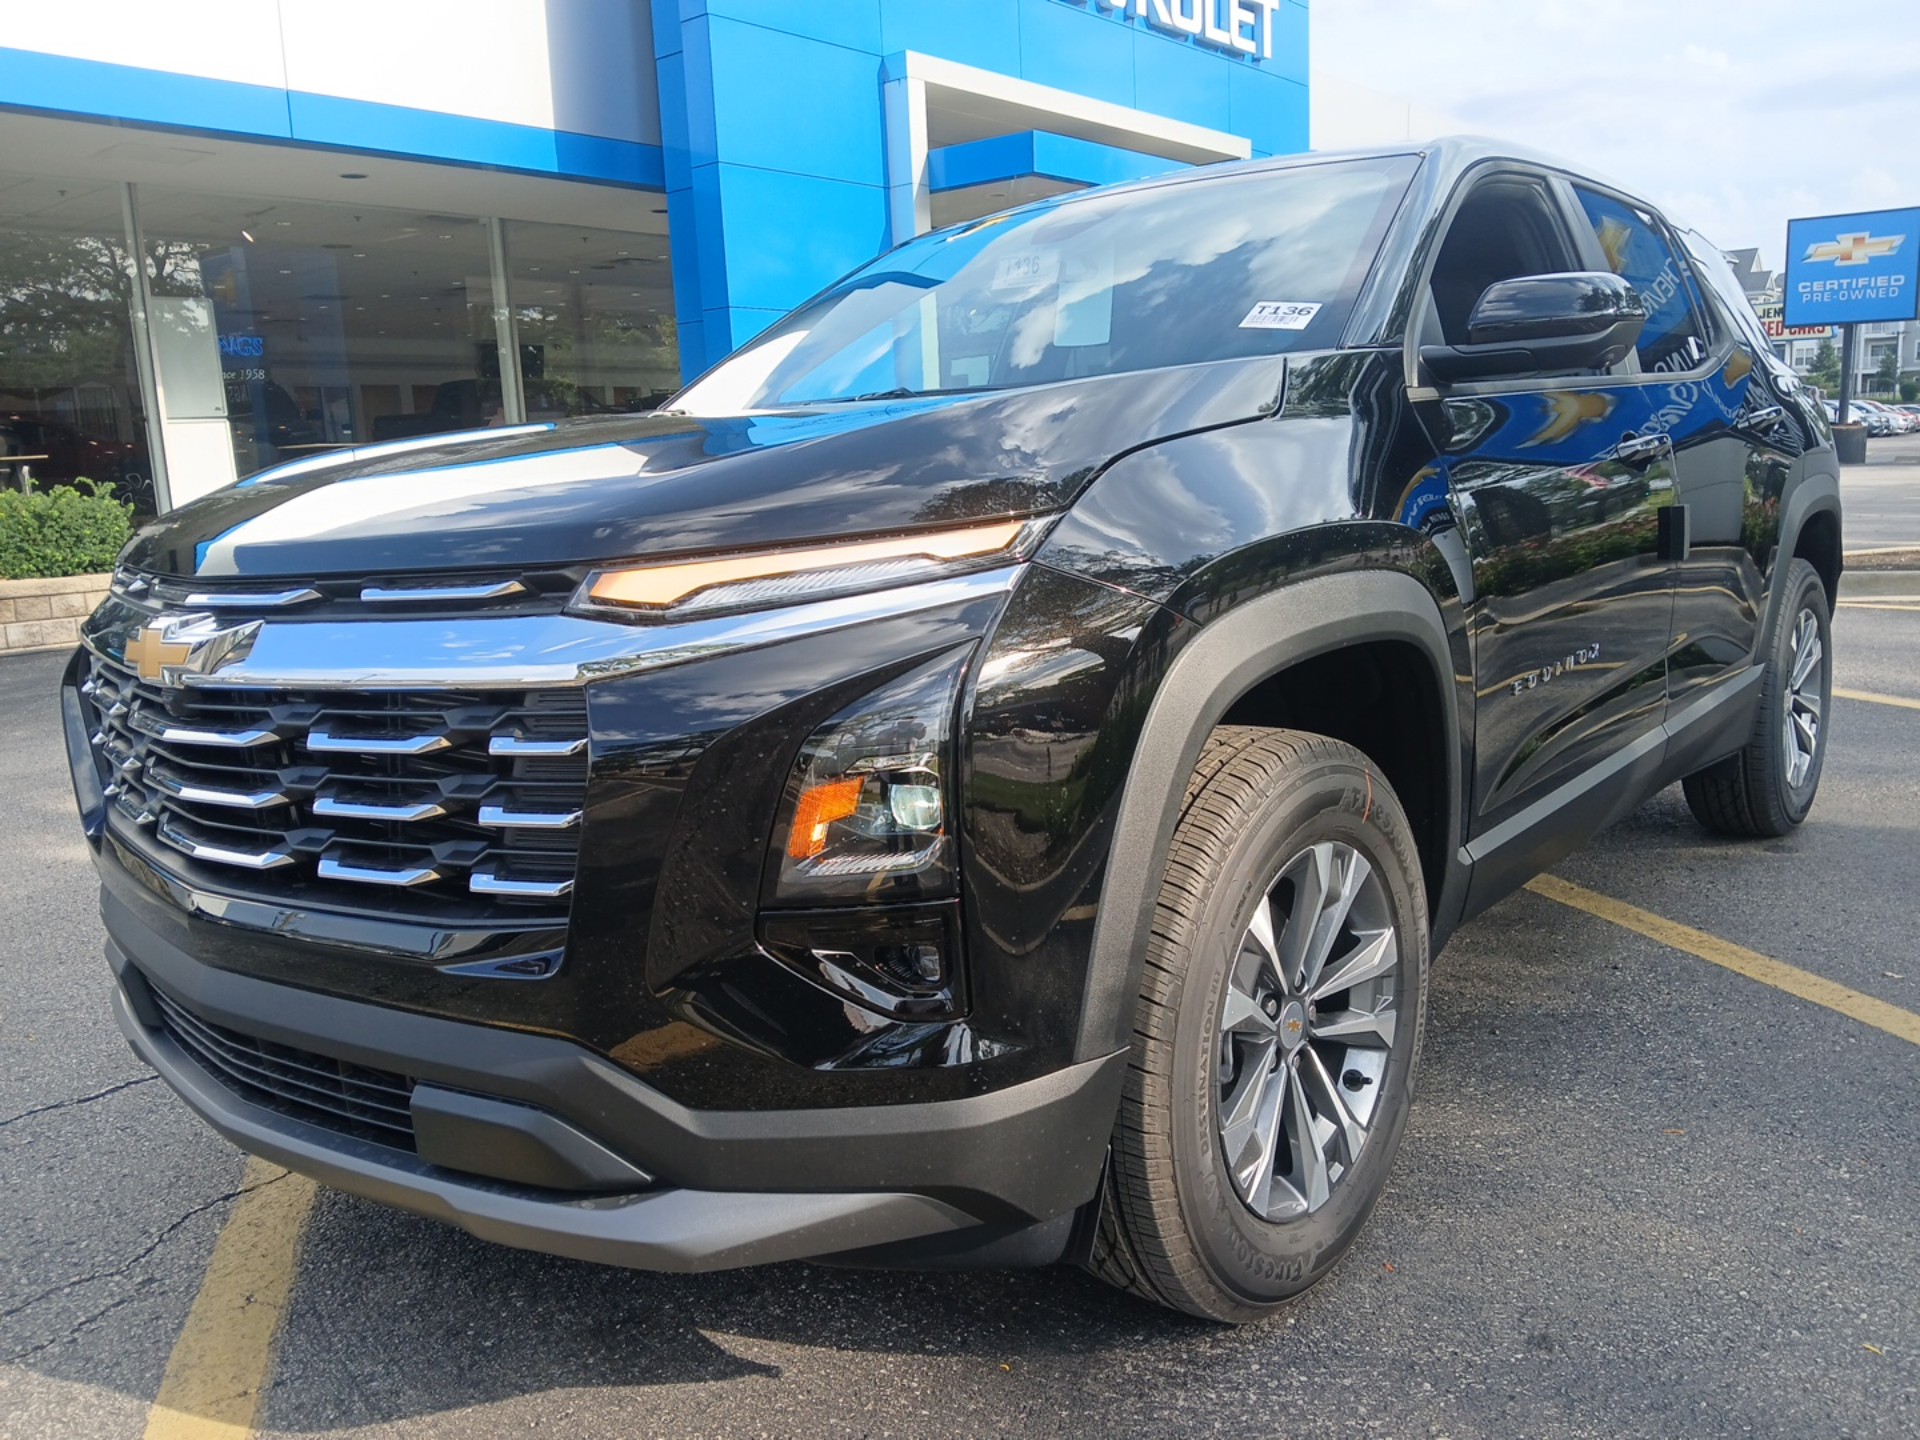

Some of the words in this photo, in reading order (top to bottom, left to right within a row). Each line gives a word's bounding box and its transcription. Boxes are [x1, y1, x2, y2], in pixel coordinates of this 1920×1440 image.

[1107, 0, 1279, 59] OLET
[1798, 275, 1905, 293] CERTIFIED
[1802, 287, 1899, 304] PRE-OWNED
[1258, 305, 1314, 316] T136
[1760, 307, 1784, 319] JEN
[240, 369, 265, 380] 1958
[1198, 1000, 1215, 1156] DESTINATION
